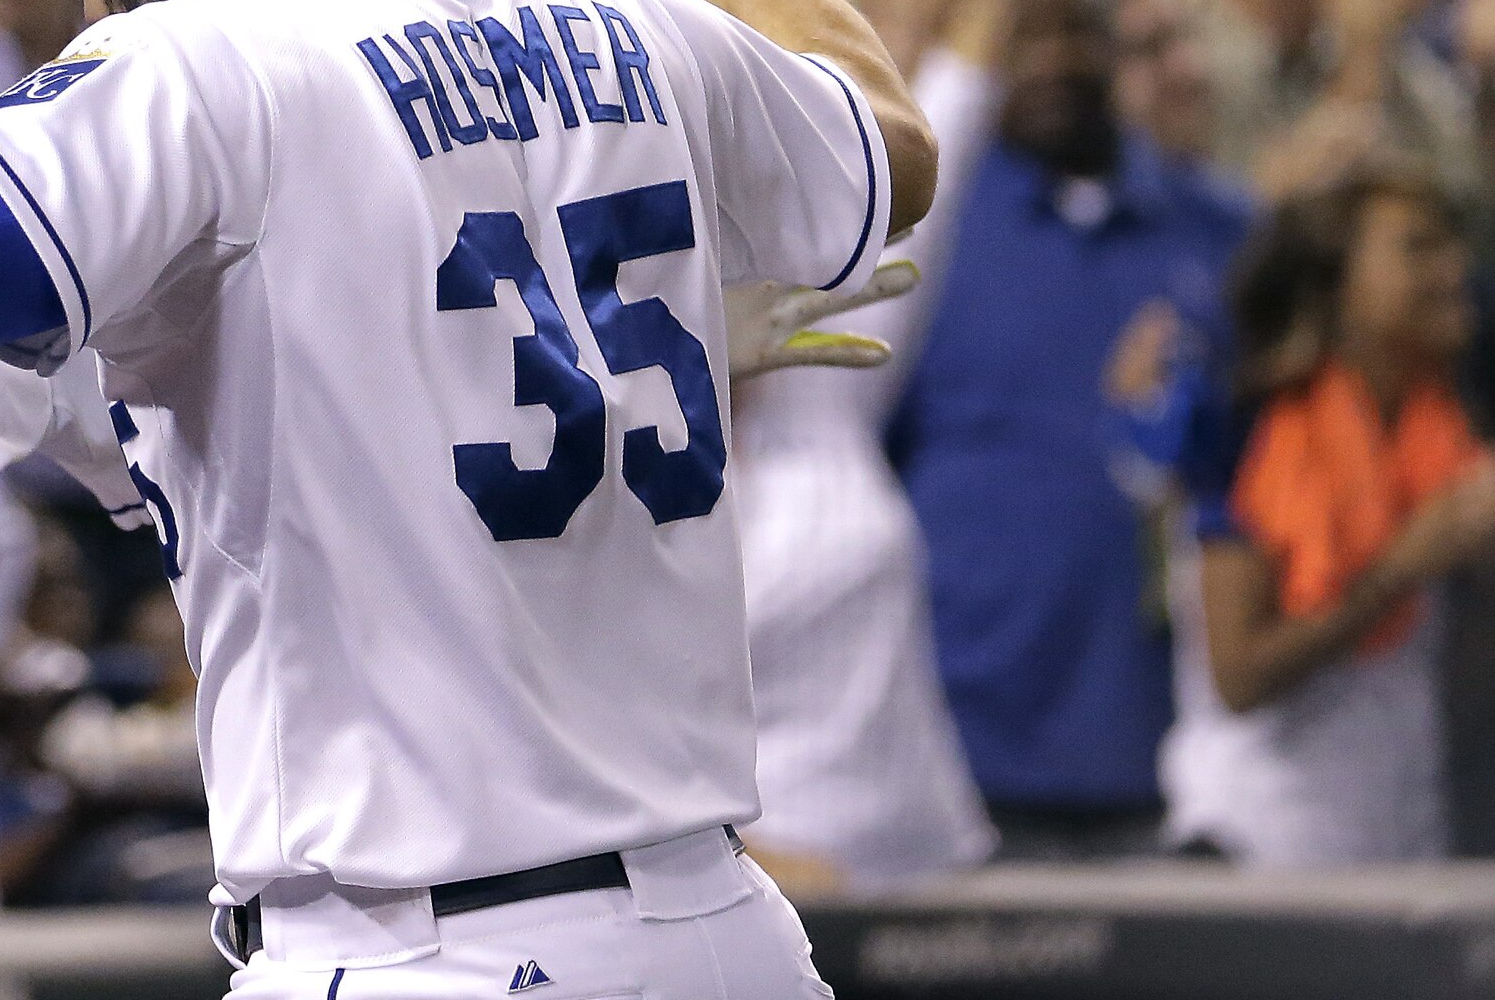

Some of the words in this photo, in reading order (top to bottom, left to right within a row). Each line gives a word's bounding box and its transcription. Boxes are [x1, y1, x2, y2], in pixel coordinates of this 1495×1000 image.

[2, 69, 85, 99] KC
[356, 0, 668, 160] HOSMER
[436, 179, 728, 542] 35
